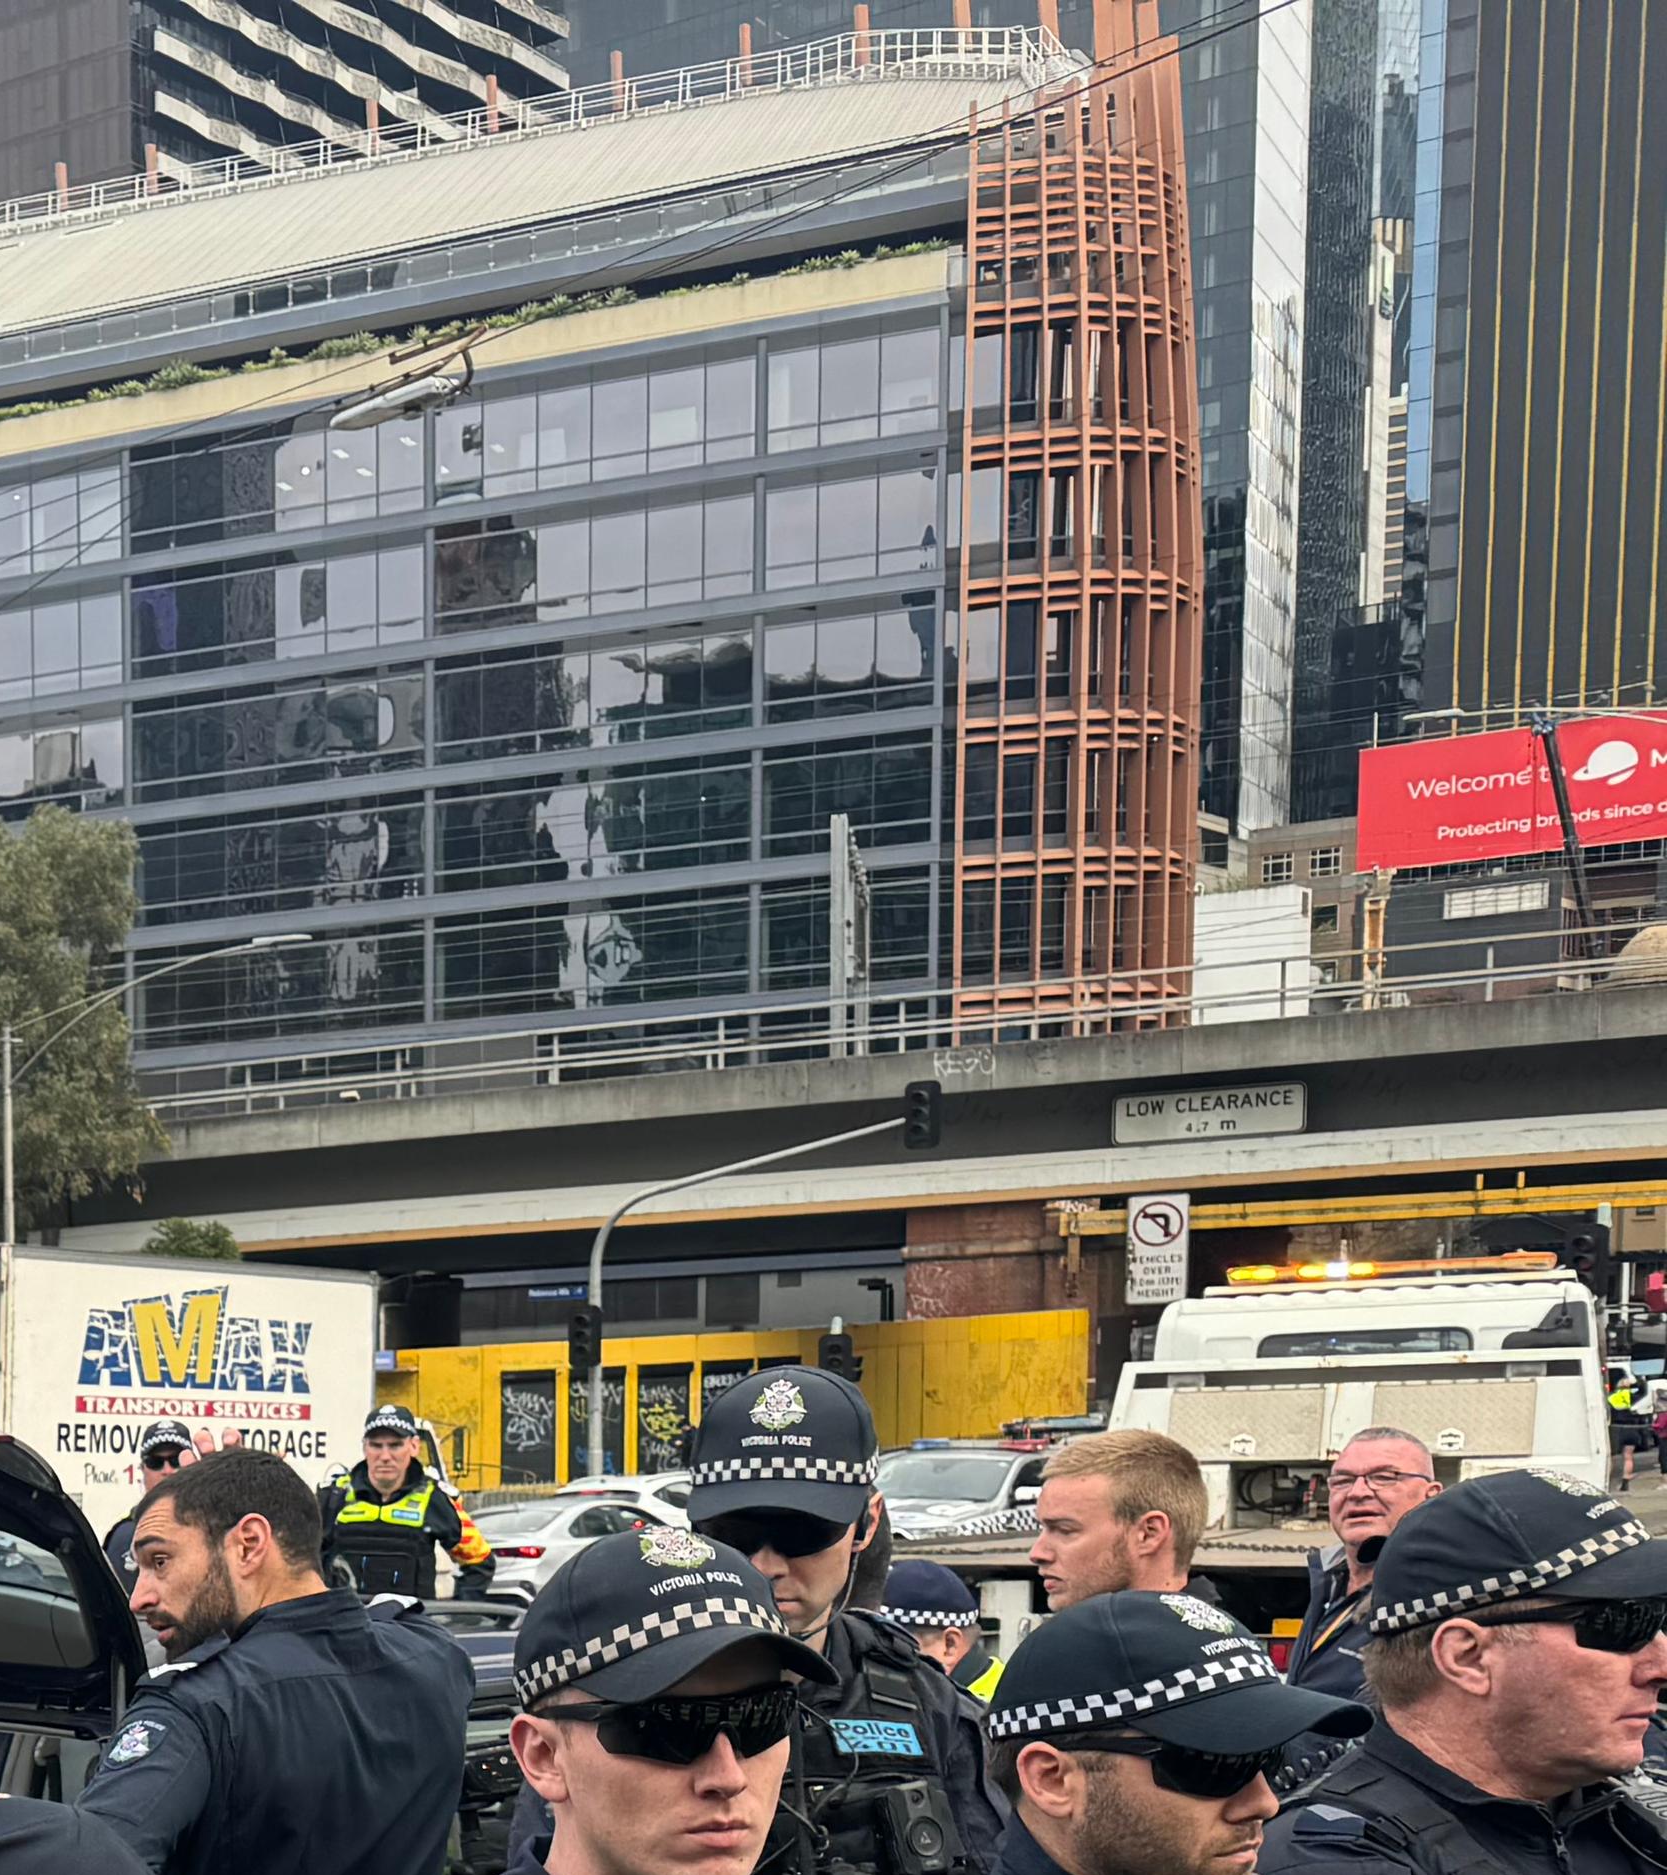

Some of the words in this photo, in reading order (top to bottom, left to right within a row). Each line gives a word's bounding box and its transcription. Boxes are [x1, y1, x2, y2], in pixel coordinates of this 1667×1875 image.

[1407, 766, 1533, 800] Welcome
[1437, 817, 1531, 840] Protecting
[1603, 801, 1653, 819] since
[1126, 1100, 1165, 1117] LOW
[1175, 1089, 1294, 1113] CLEARANCE
[1185, 1121, 1209, 1133] 4.7
[1220, 1119, 1236, 1131] m
[1143, 1265, 1171, 1275] OVER
[77, 1285, 312, 1393] AMAX
[82, 1396, 208, 1416] TRANSPORT
[212, 1401, 302, 1419] SERVICES
[57, 1423, 142, 1454] REMOV
[239, 1429, 327, 1458] TORAGE
[741, 1435, 778, 1447] VICTORIA
[781, 1435, 812, 1447] POLICE
[649, 1573, 705, 1596] VICTORIA
[708, 1571, 744, 1587] POLICE
[834, 1721, 911, 1738] Police
